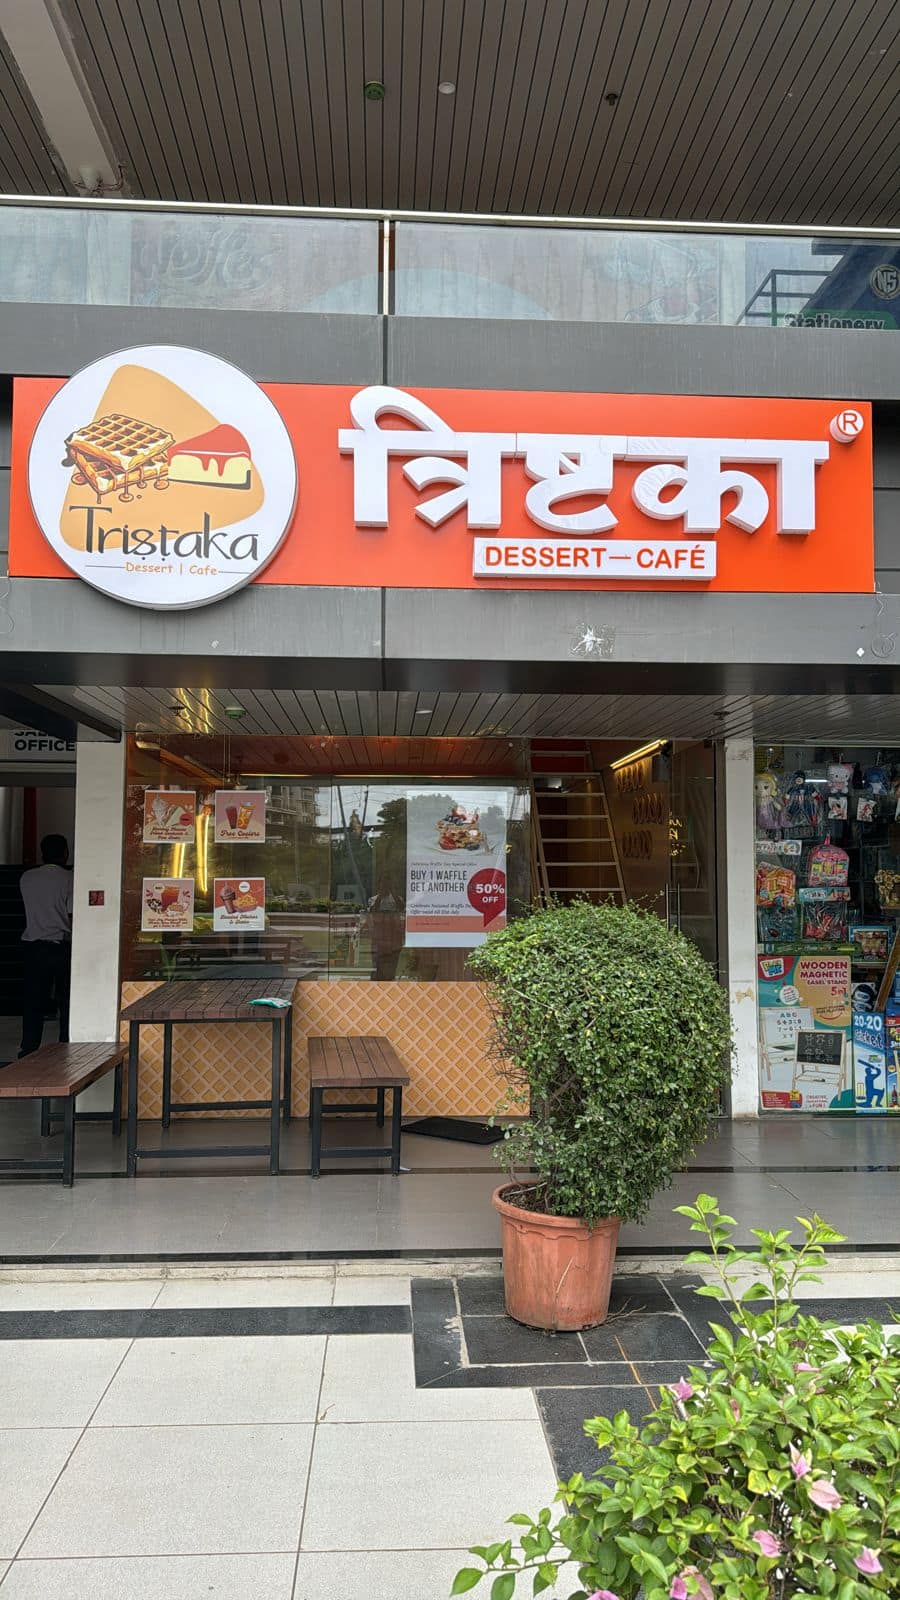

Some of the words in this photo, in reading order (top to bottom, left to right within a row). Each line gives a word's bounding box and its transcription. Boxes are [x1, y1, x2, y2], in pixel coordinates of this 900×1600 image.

[484, 545, 607, 569] DESSERT
[125, 561, 173, 574] Dessert
[188, 563, 218, 576] Cafe
[14, 739, 76, 752] OFFICE
[410, 870, 427, 880] BUY
[436, 870, 468, 880] WAFFLE
[410, 882, 425, 892] GET
[428, 882, 465, 892] ANOTHER
[475, 883, 505, 894] 50%
